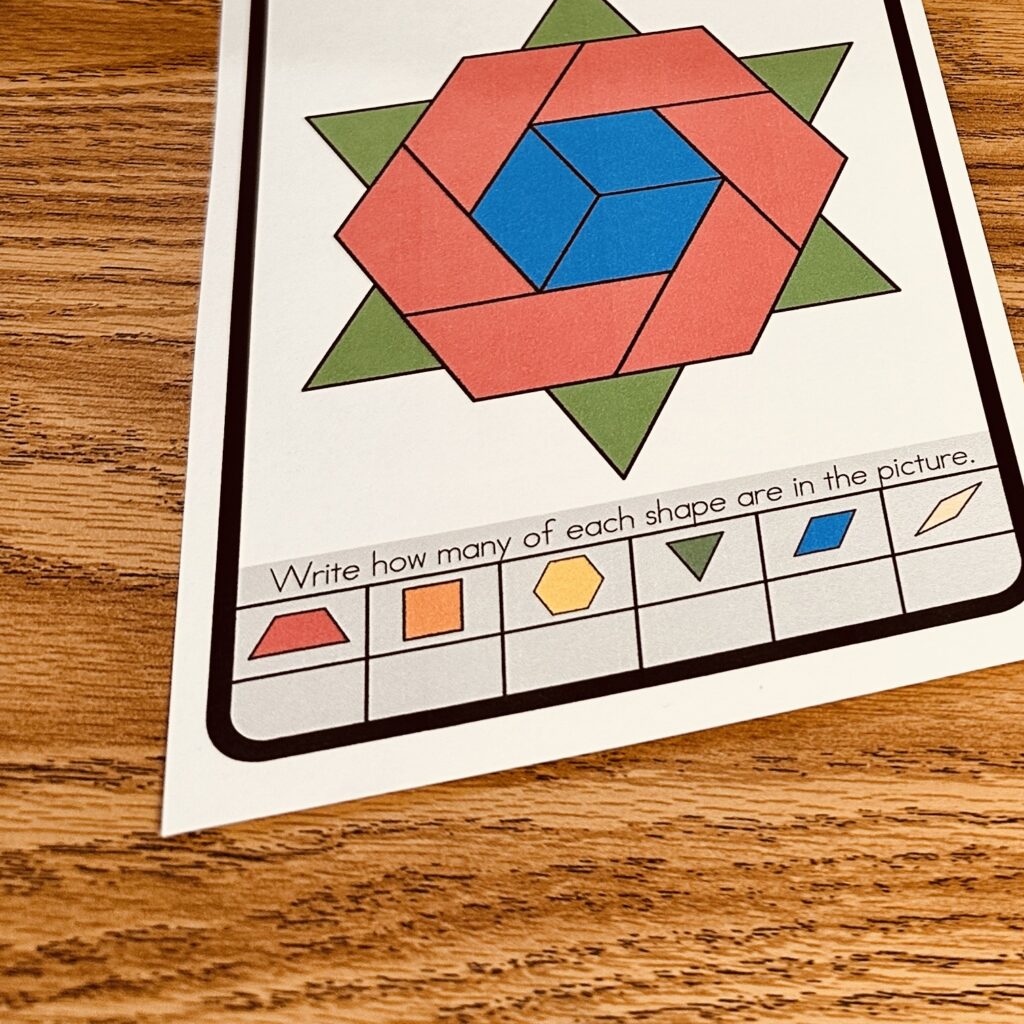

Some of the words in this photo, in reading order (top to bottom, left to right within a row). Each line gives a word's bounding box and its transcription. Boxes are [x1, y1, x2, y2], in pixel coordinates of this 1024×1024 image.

[270, 561, 360, 593] Write
[371, 550, 427, 577] how
[437, 536, 511, 561] many
[523, 518, 556, 549] of
[566, 506, 635, 540] each
[645, 498, 726, 526] shape
[737, 486, 783, 507] are
[793, 477, 815, 497] in
[823, 465, 867, 491] the
[877, 450, 976, 488] picture.
